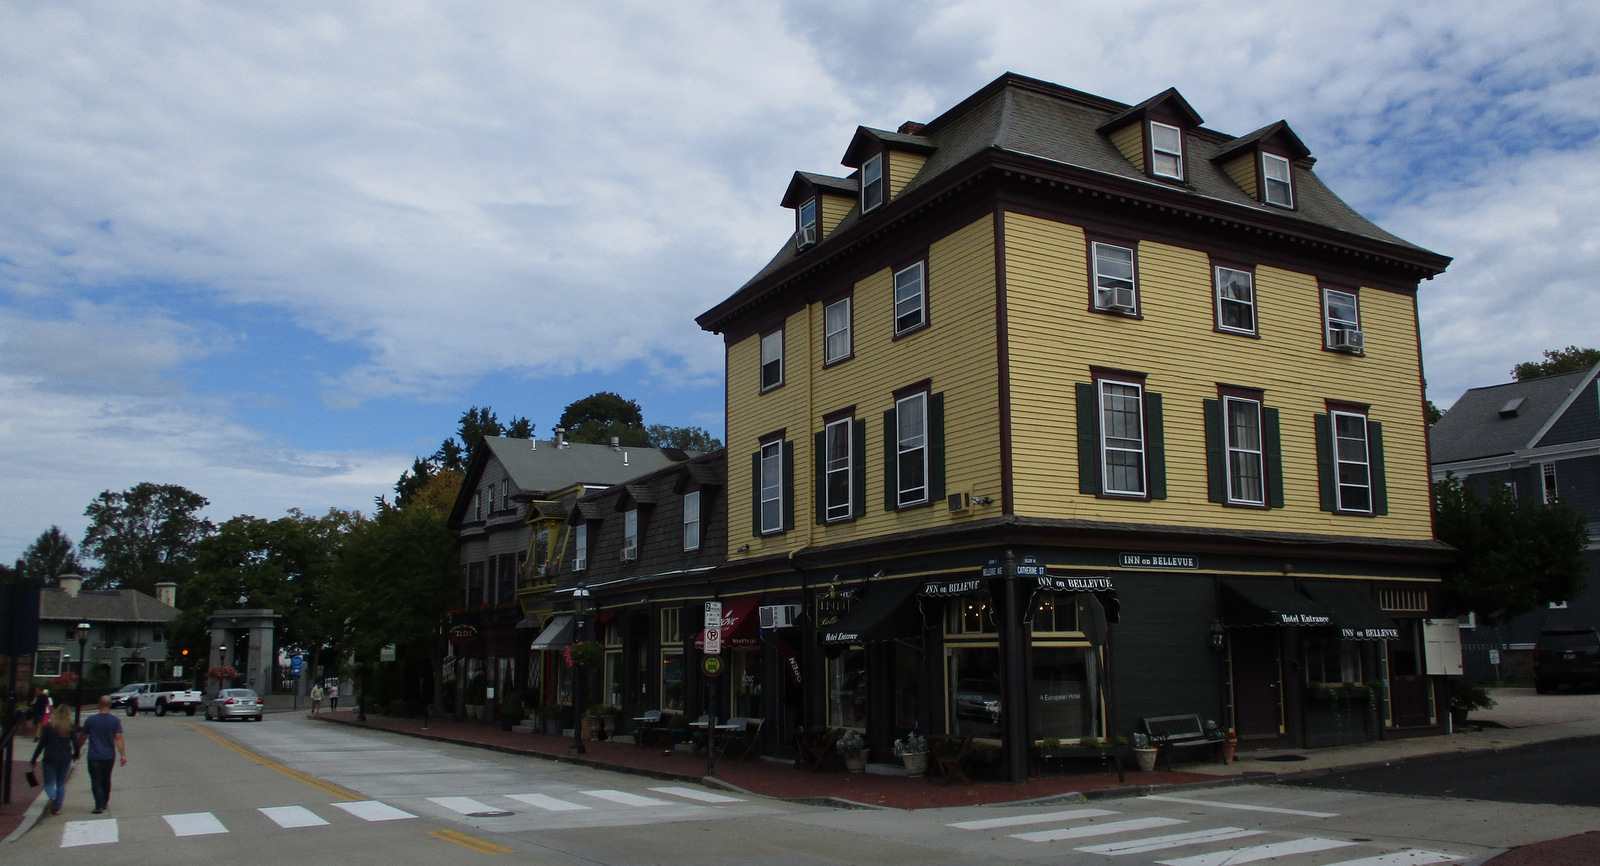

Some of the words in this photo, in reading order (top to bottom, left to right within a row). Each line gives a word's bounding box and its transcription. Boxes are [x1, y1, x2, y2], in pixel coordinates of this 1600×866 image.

[1124, 555, 1140, 564] INN
[1152, 556, 1194, 567] BELLEVUE
[1017, 566, 1038, 575] CATHERINE
[1038, 566, 1044, 575] ST
[1037, 577, 1053, 587] INN
[1067, 578, 1113, 588] BELLEVUE
[925, 584, 939, 594] INN
[1281, 614, 1300, 623] Hotel
[1300, 614, 1330, 623] Entrance
[825, 632, 838, 641] Hotel
[838, 632, 858, 641] Entrance
[1342, 628, 1354, 637] INN
[1365, 628, 1399, 638] BELLEVUE
[788, 657, 802, 682] OPEN
[1044, 694, 1067, 702] European
